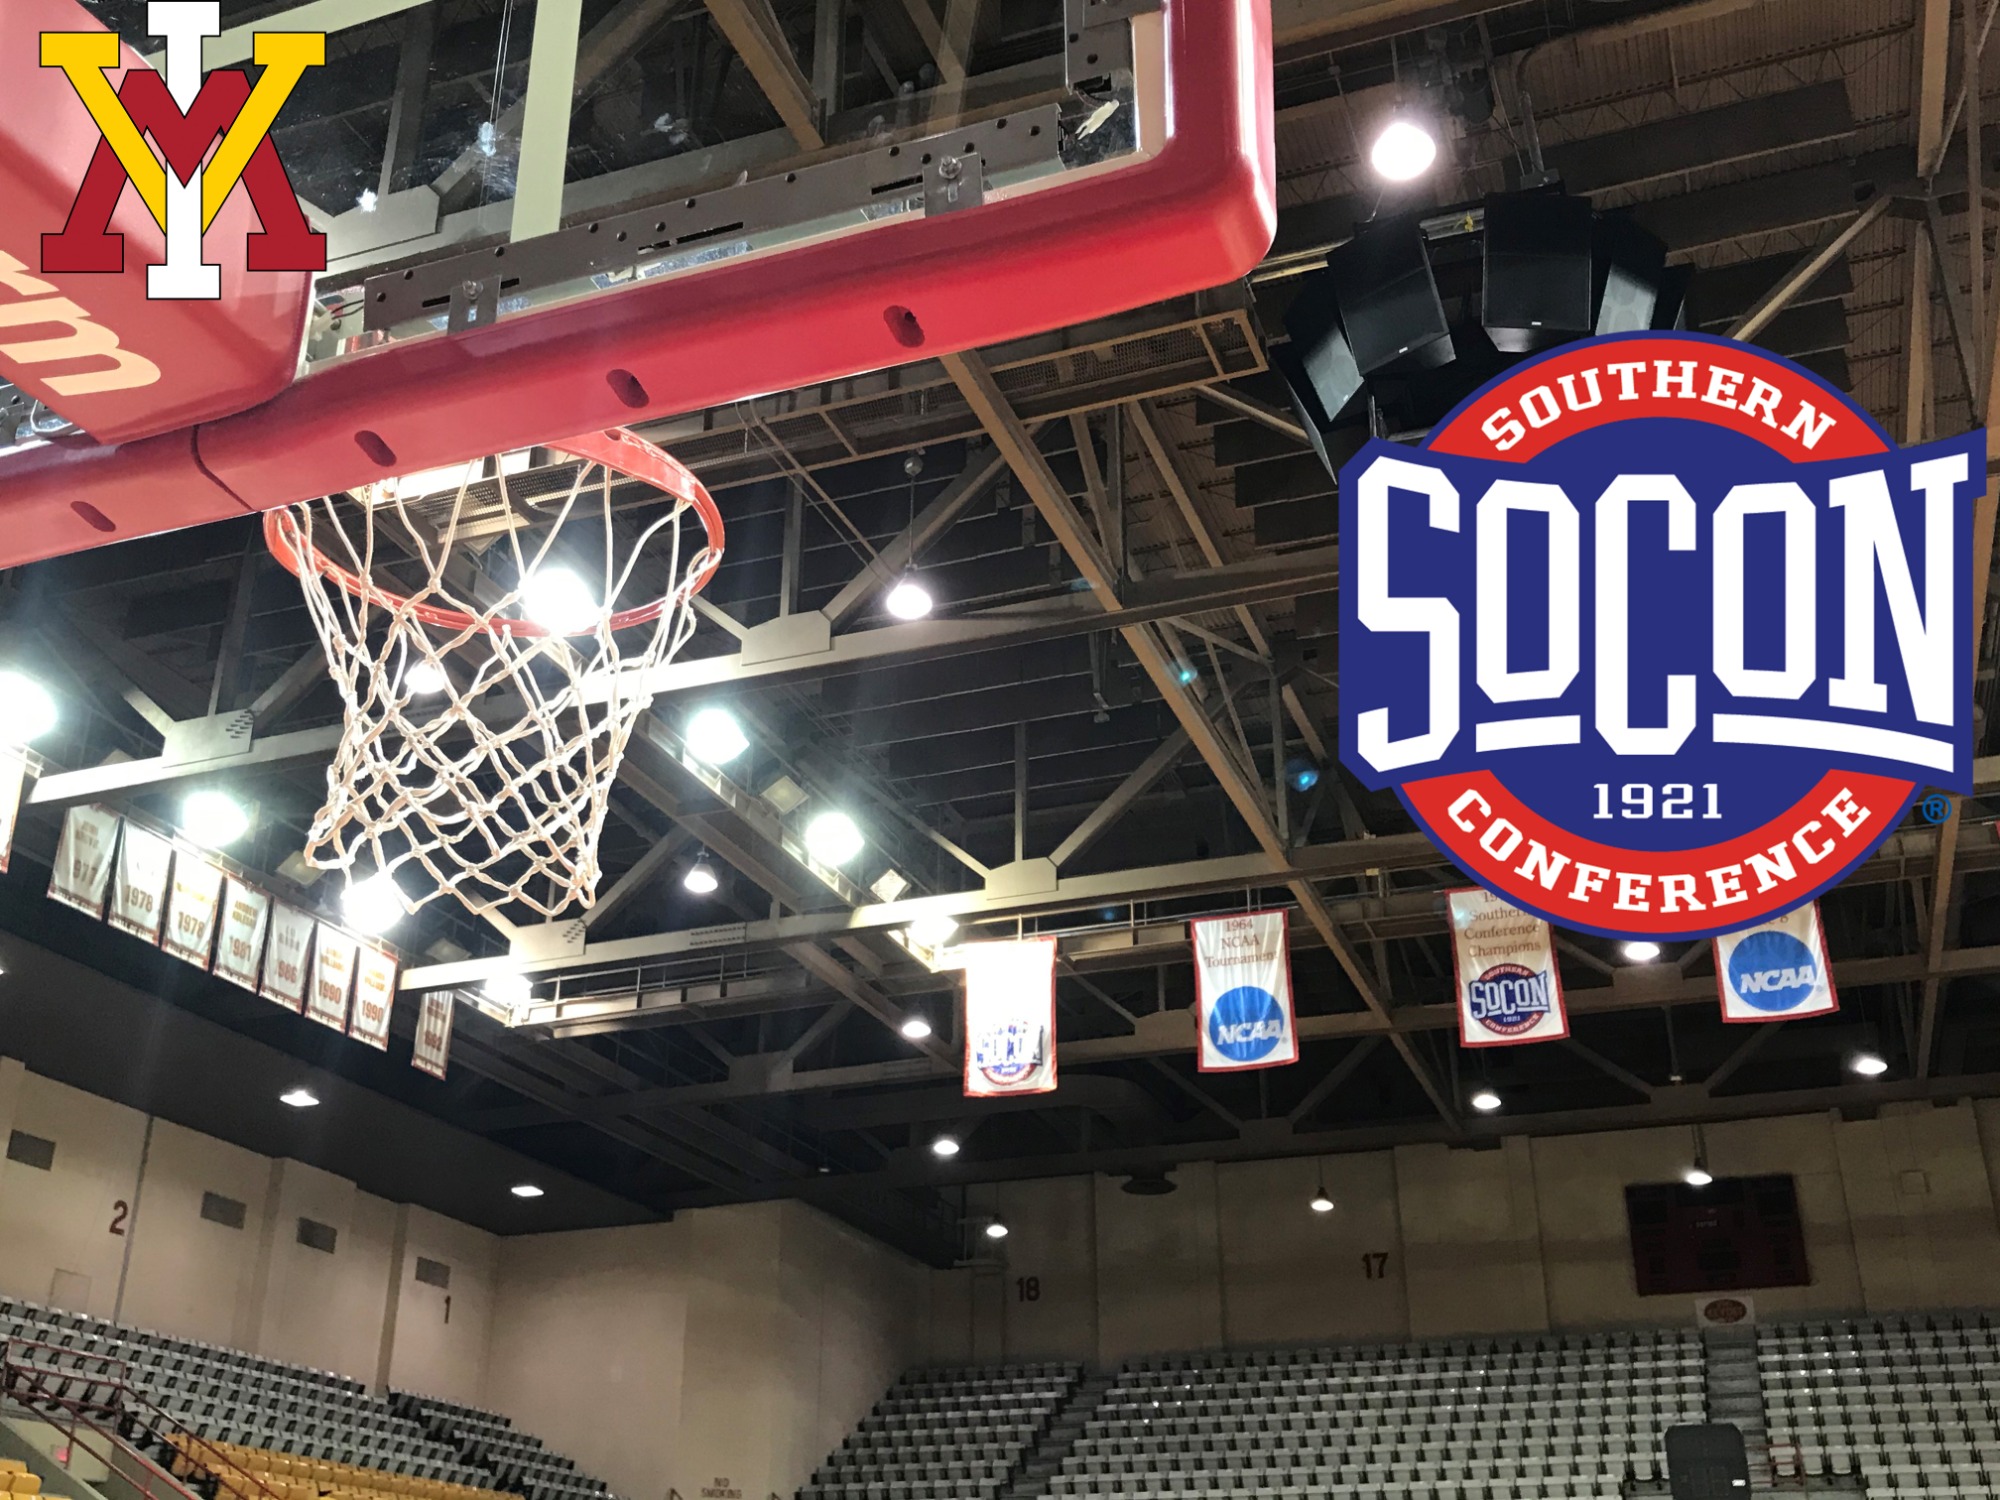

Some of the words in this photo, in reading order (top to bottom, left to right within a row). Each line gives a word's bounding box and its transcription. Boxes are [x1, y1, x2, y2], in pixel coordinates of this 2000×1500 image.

[123, 885, 153, 913] 1978
[177, 911, 206, 939] 1978
[1225, 918, 1254, 932] 1964
[1464, 923, 1540, 940] Conference
[1221, 933, 1261, 950] NCAA
[1468, 940, 1542, 958] Champions
[319, 979, 342, 1005] 1990
[1740, 965, 1816, 994] NCAA
[361, 999, 384, 1024] 1990
[1217, 1019, 1281, 1046] NCAA
[109, 1199, 128, 1236] 2
[1362, 1252, 1389, 1279] 17
[1016, 1276, 1041, 1302] 18
[444, 1295, 451, 1324] 1
